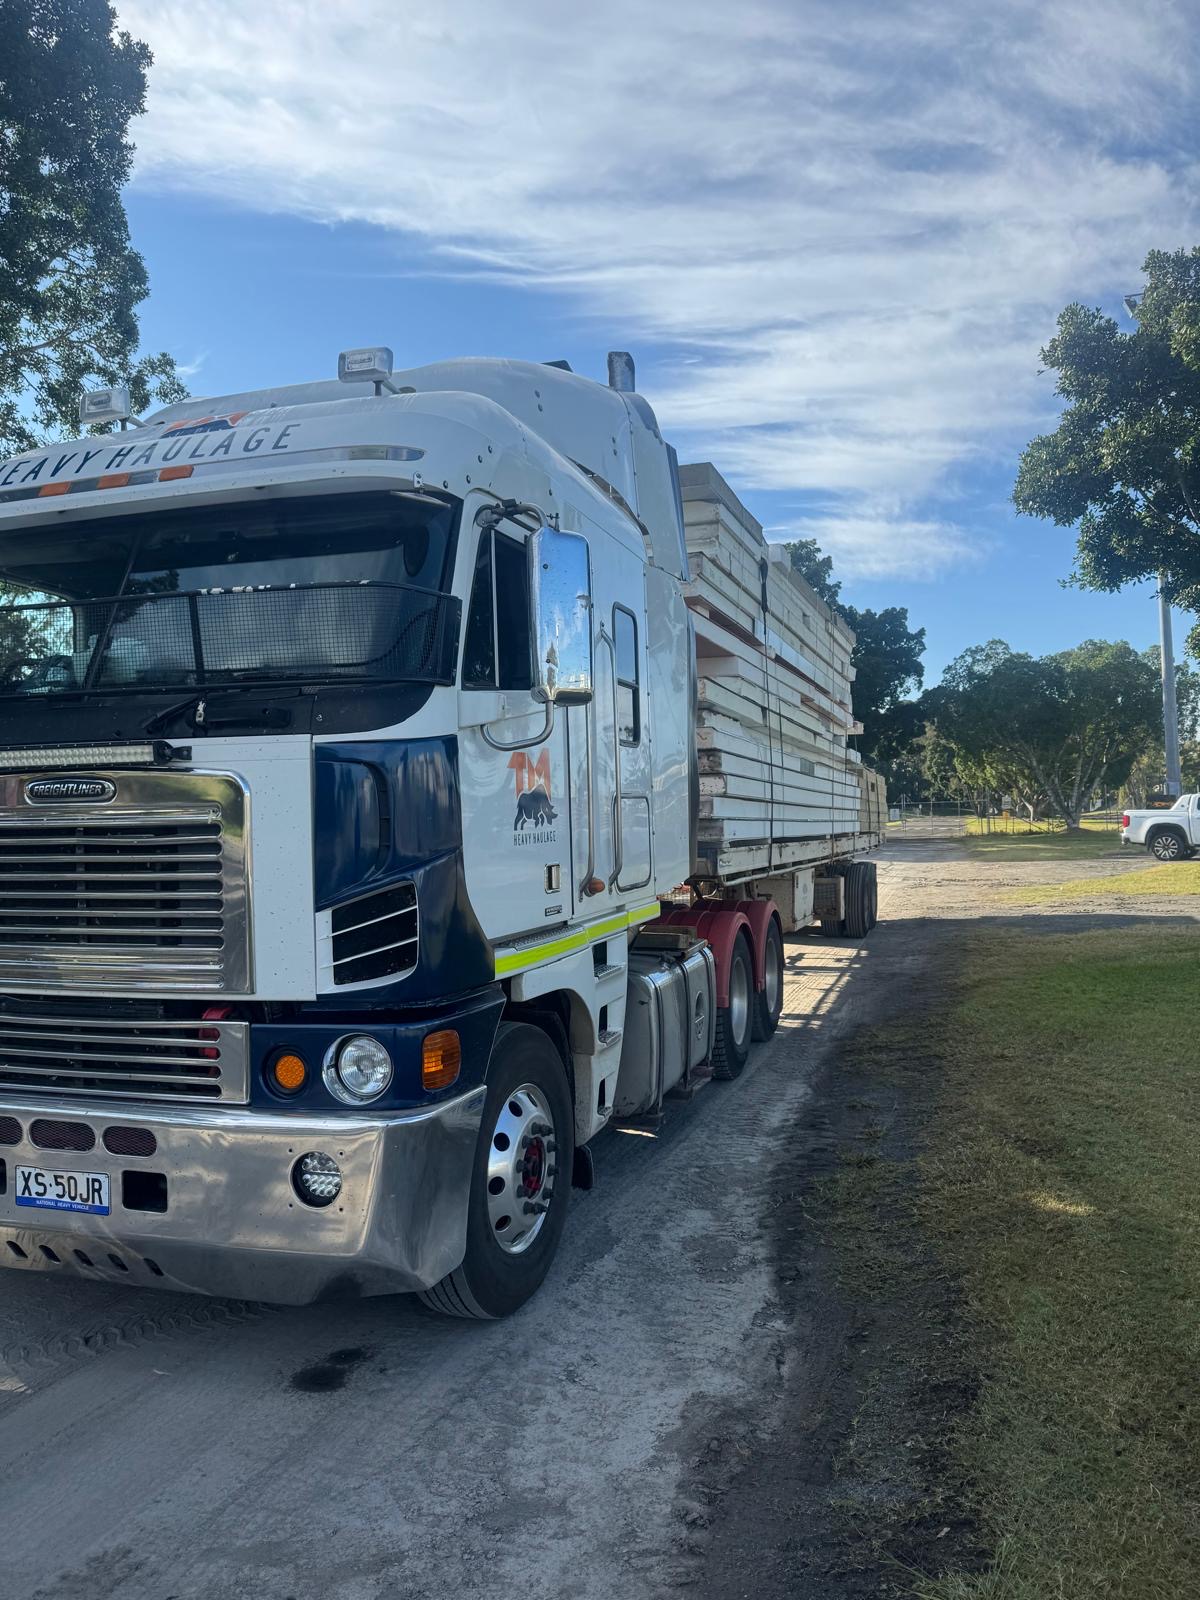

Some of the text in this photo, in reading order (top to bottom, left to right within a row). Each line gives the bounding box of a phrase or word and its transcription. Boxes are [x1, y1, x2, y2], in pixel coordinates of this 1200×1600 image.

[0, 423, 302, 487] EAVY HAULAGE
[32, 783, 103, 796] FREIGHTLINER
[513, 830, 556, 846] HEAVY HAULAGE
[36, 1199, 56, 1207] NATIONAL
